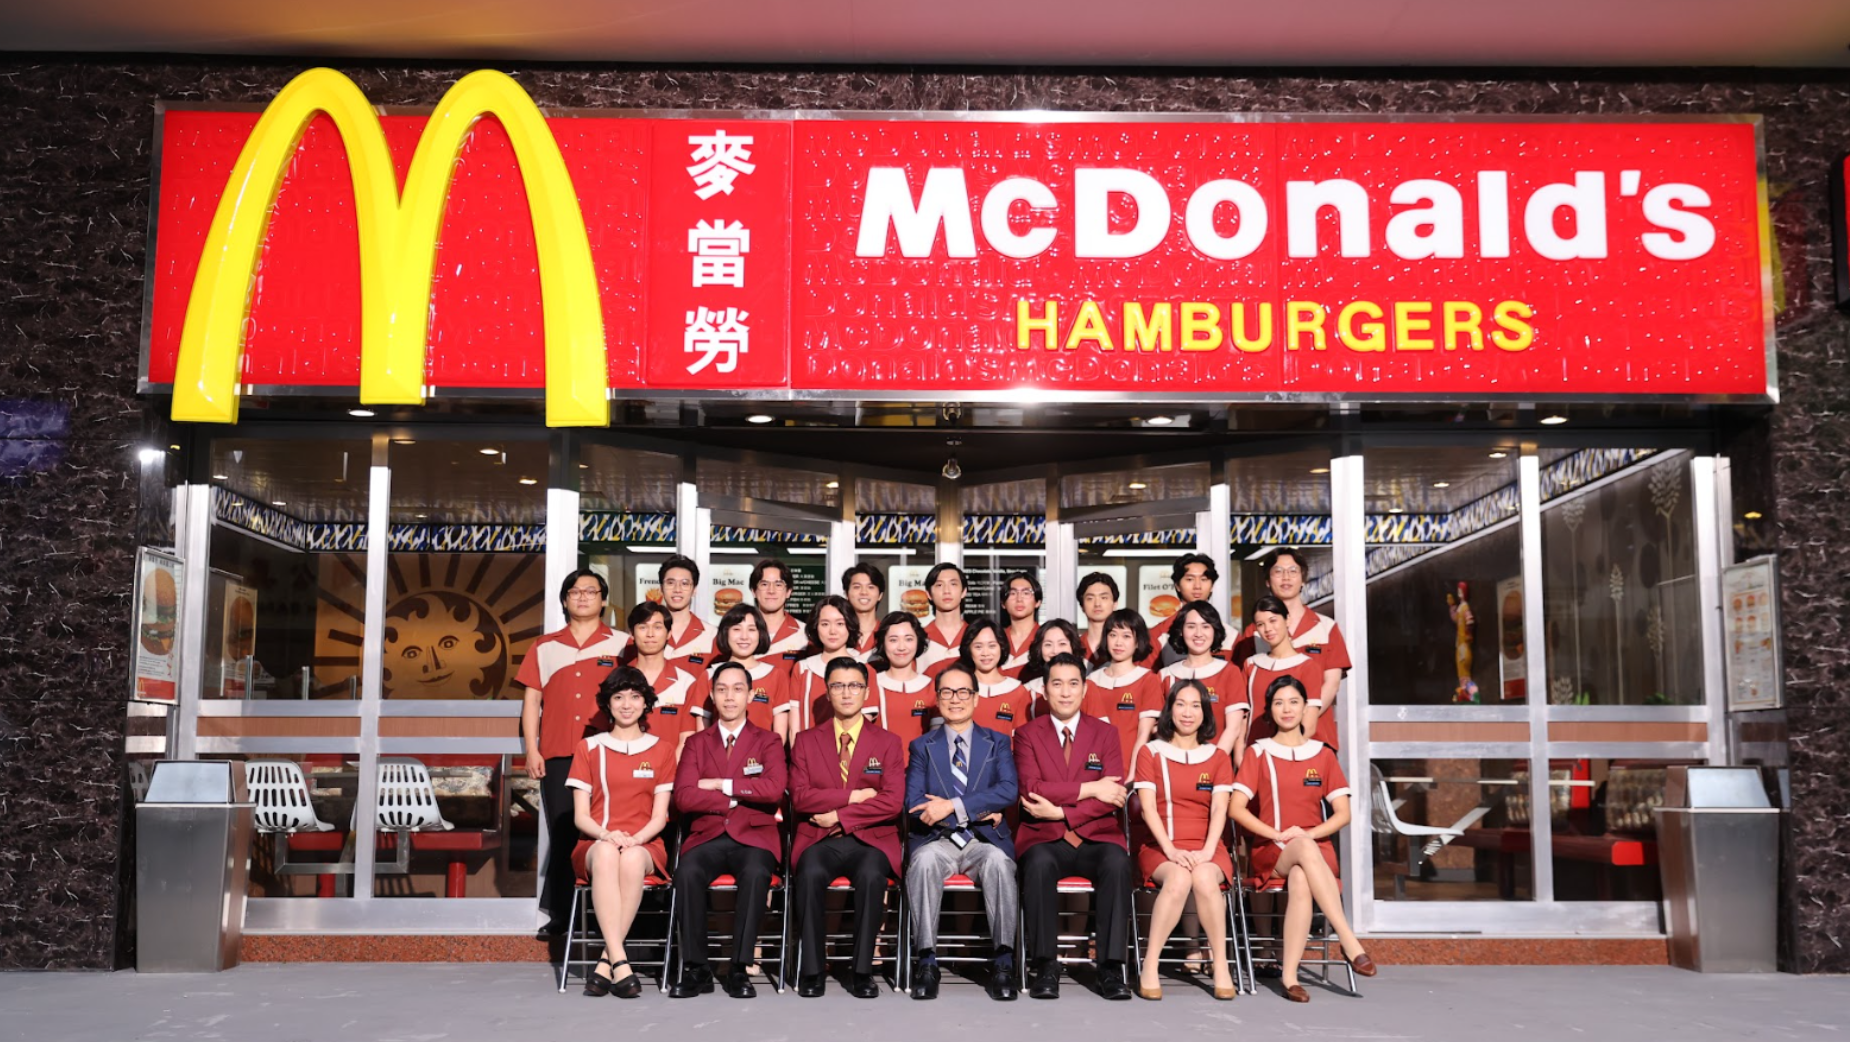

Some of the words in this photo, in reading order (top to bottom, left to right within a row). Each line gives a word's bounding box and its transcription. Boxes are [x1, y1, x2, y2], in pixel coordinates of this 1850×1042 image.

[855, 167, 1715, 261] McDonald's
[684, 129, 756, 375] 麥當勞
[1016, 299, 1535, 353] HAMBURGERS
[712, 578, 726, 586] Big
[727, 578, 745, 586] Mac
[898, 579, 912, 588] Big
